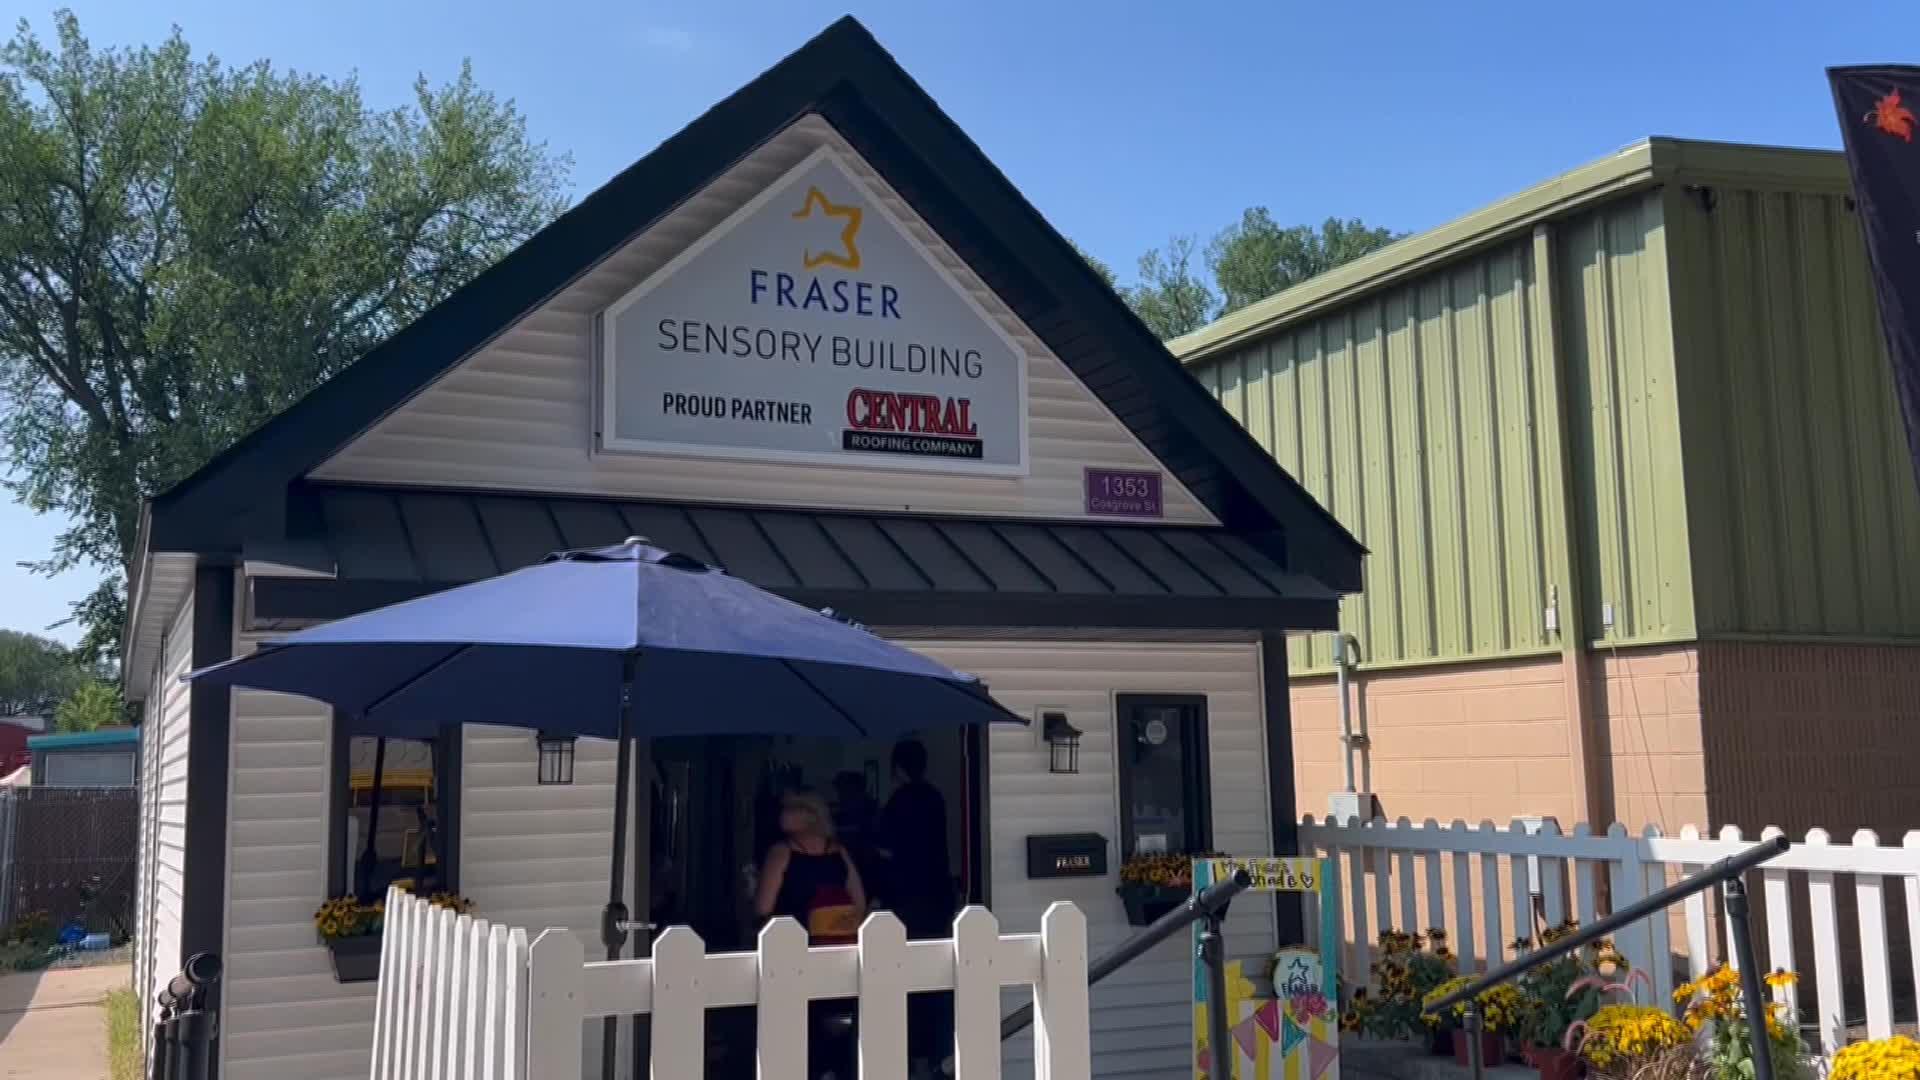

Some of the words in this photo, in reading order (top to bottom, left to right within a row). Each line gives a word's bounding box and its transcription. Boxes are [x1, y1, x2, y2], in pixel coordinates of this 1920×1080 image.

[750, 269, 902, 319] FRASER
[657, 318, 823, 363] SENSORY
[832, 336, 984, 378] BUILDING
[662, 392, 726, 420] PROUD
[731, 397, 812, 425] PARTNER
[846, 387, 978, 438] CENTRAL
[851, 435, 909, 452] ROOFING
[912, 438, 975, 456] COMPANY
[1103, 475, 1149, 498] 1353
